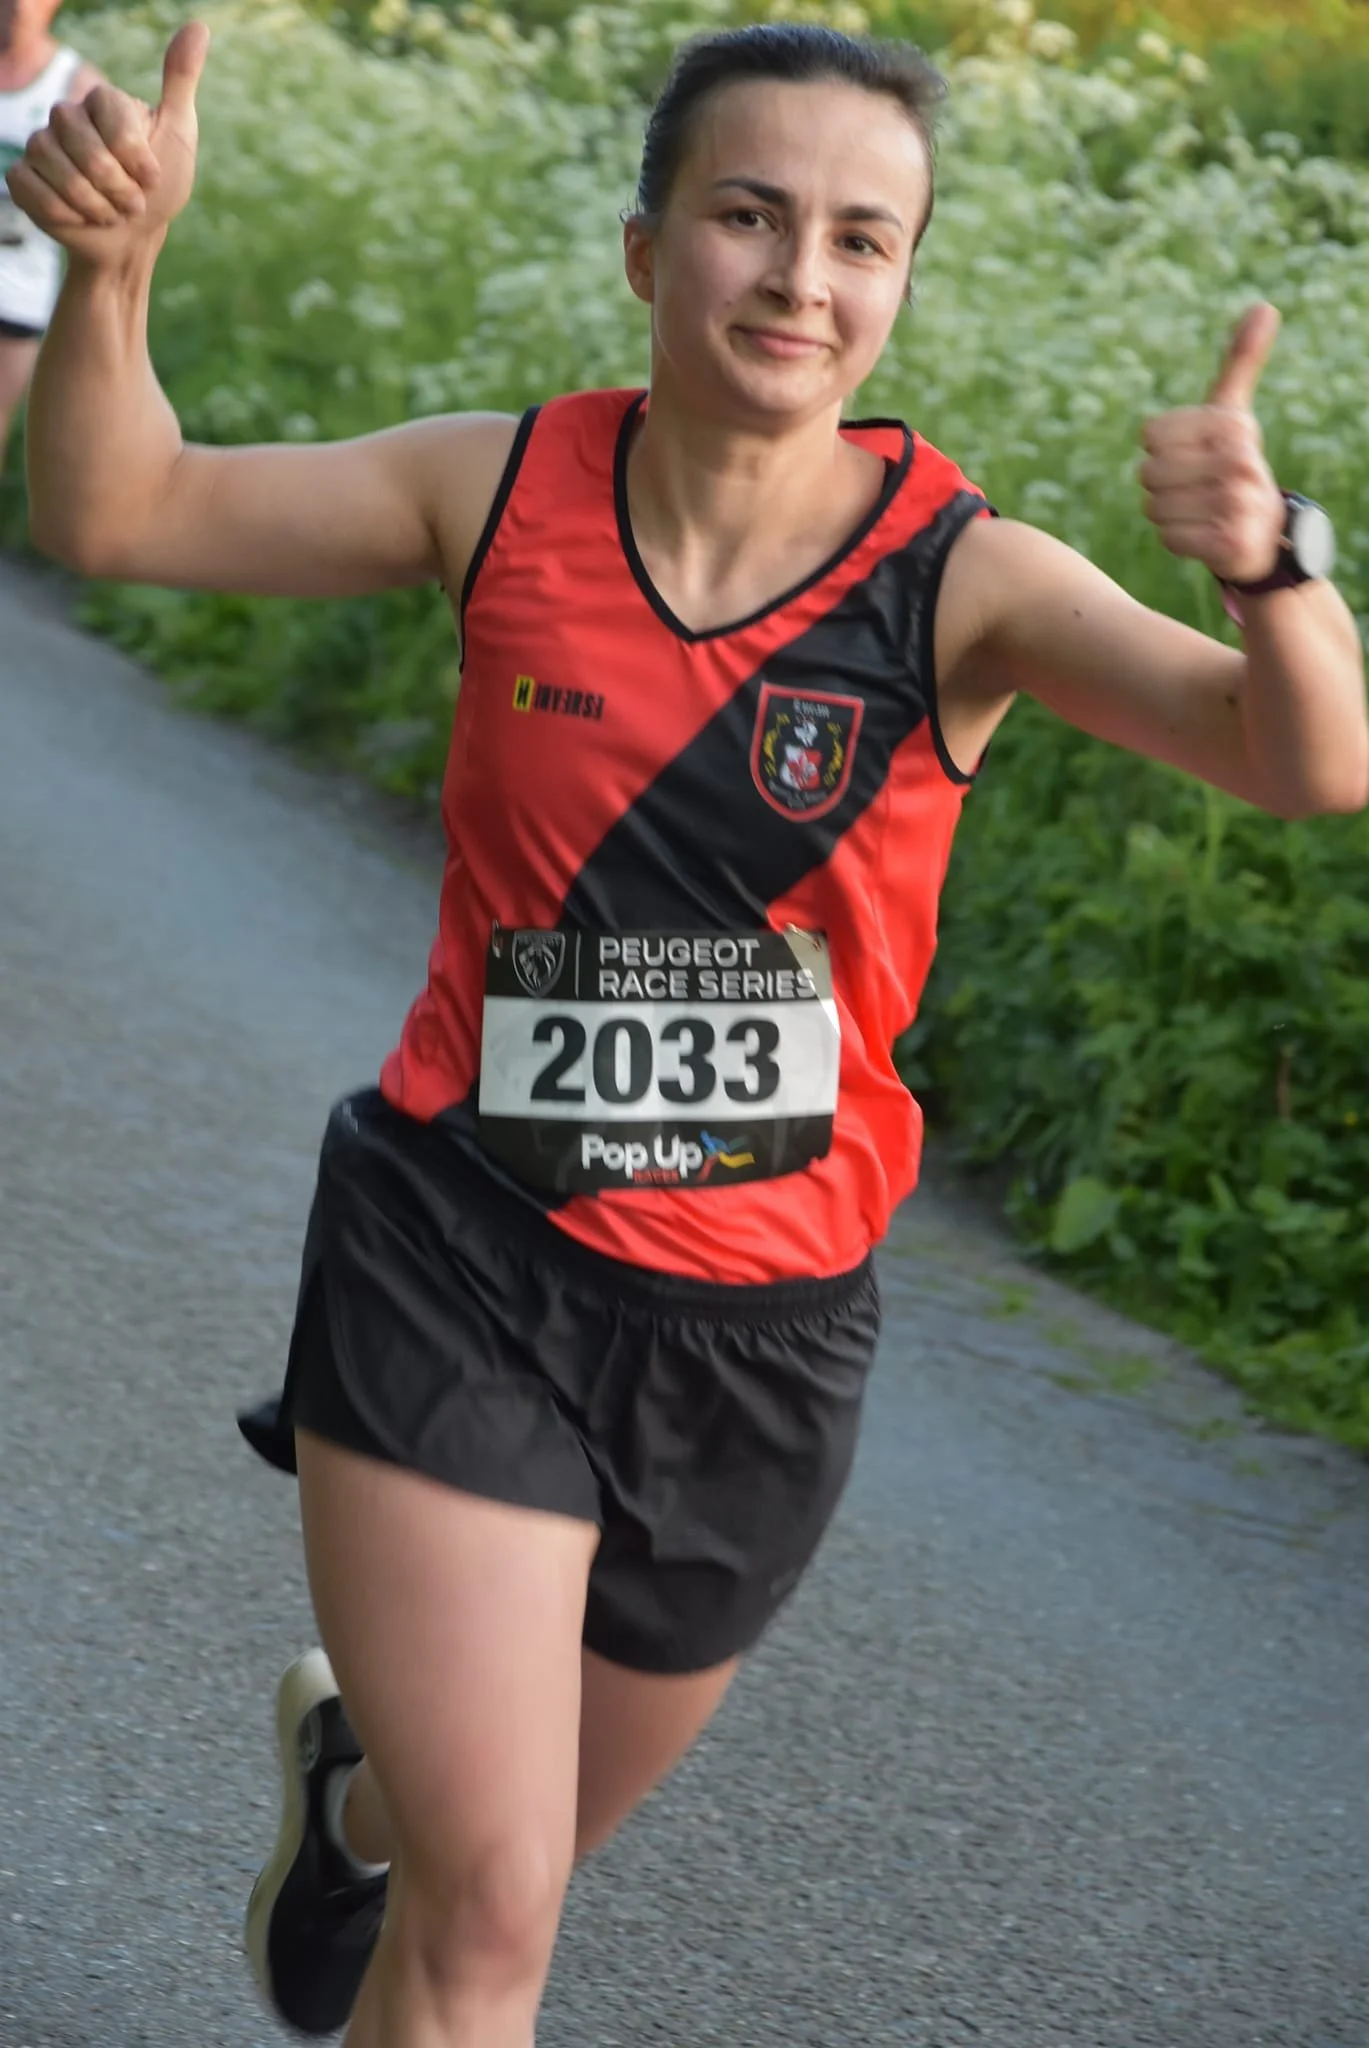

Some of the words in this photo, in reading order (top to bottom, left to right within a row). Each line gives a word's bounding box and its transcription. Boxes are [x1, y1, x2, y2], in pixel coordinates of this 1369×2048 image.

[599, 936, 760, 967] PEUGEOT
[598, 968, 689, 999] RACE
[698, 968, 818, 1000] SERIES
[529, 1014, 781, 1106] 2033
[581, 1133, 650, 1179] Pop
[653, 1133, 703, 1179] Up
